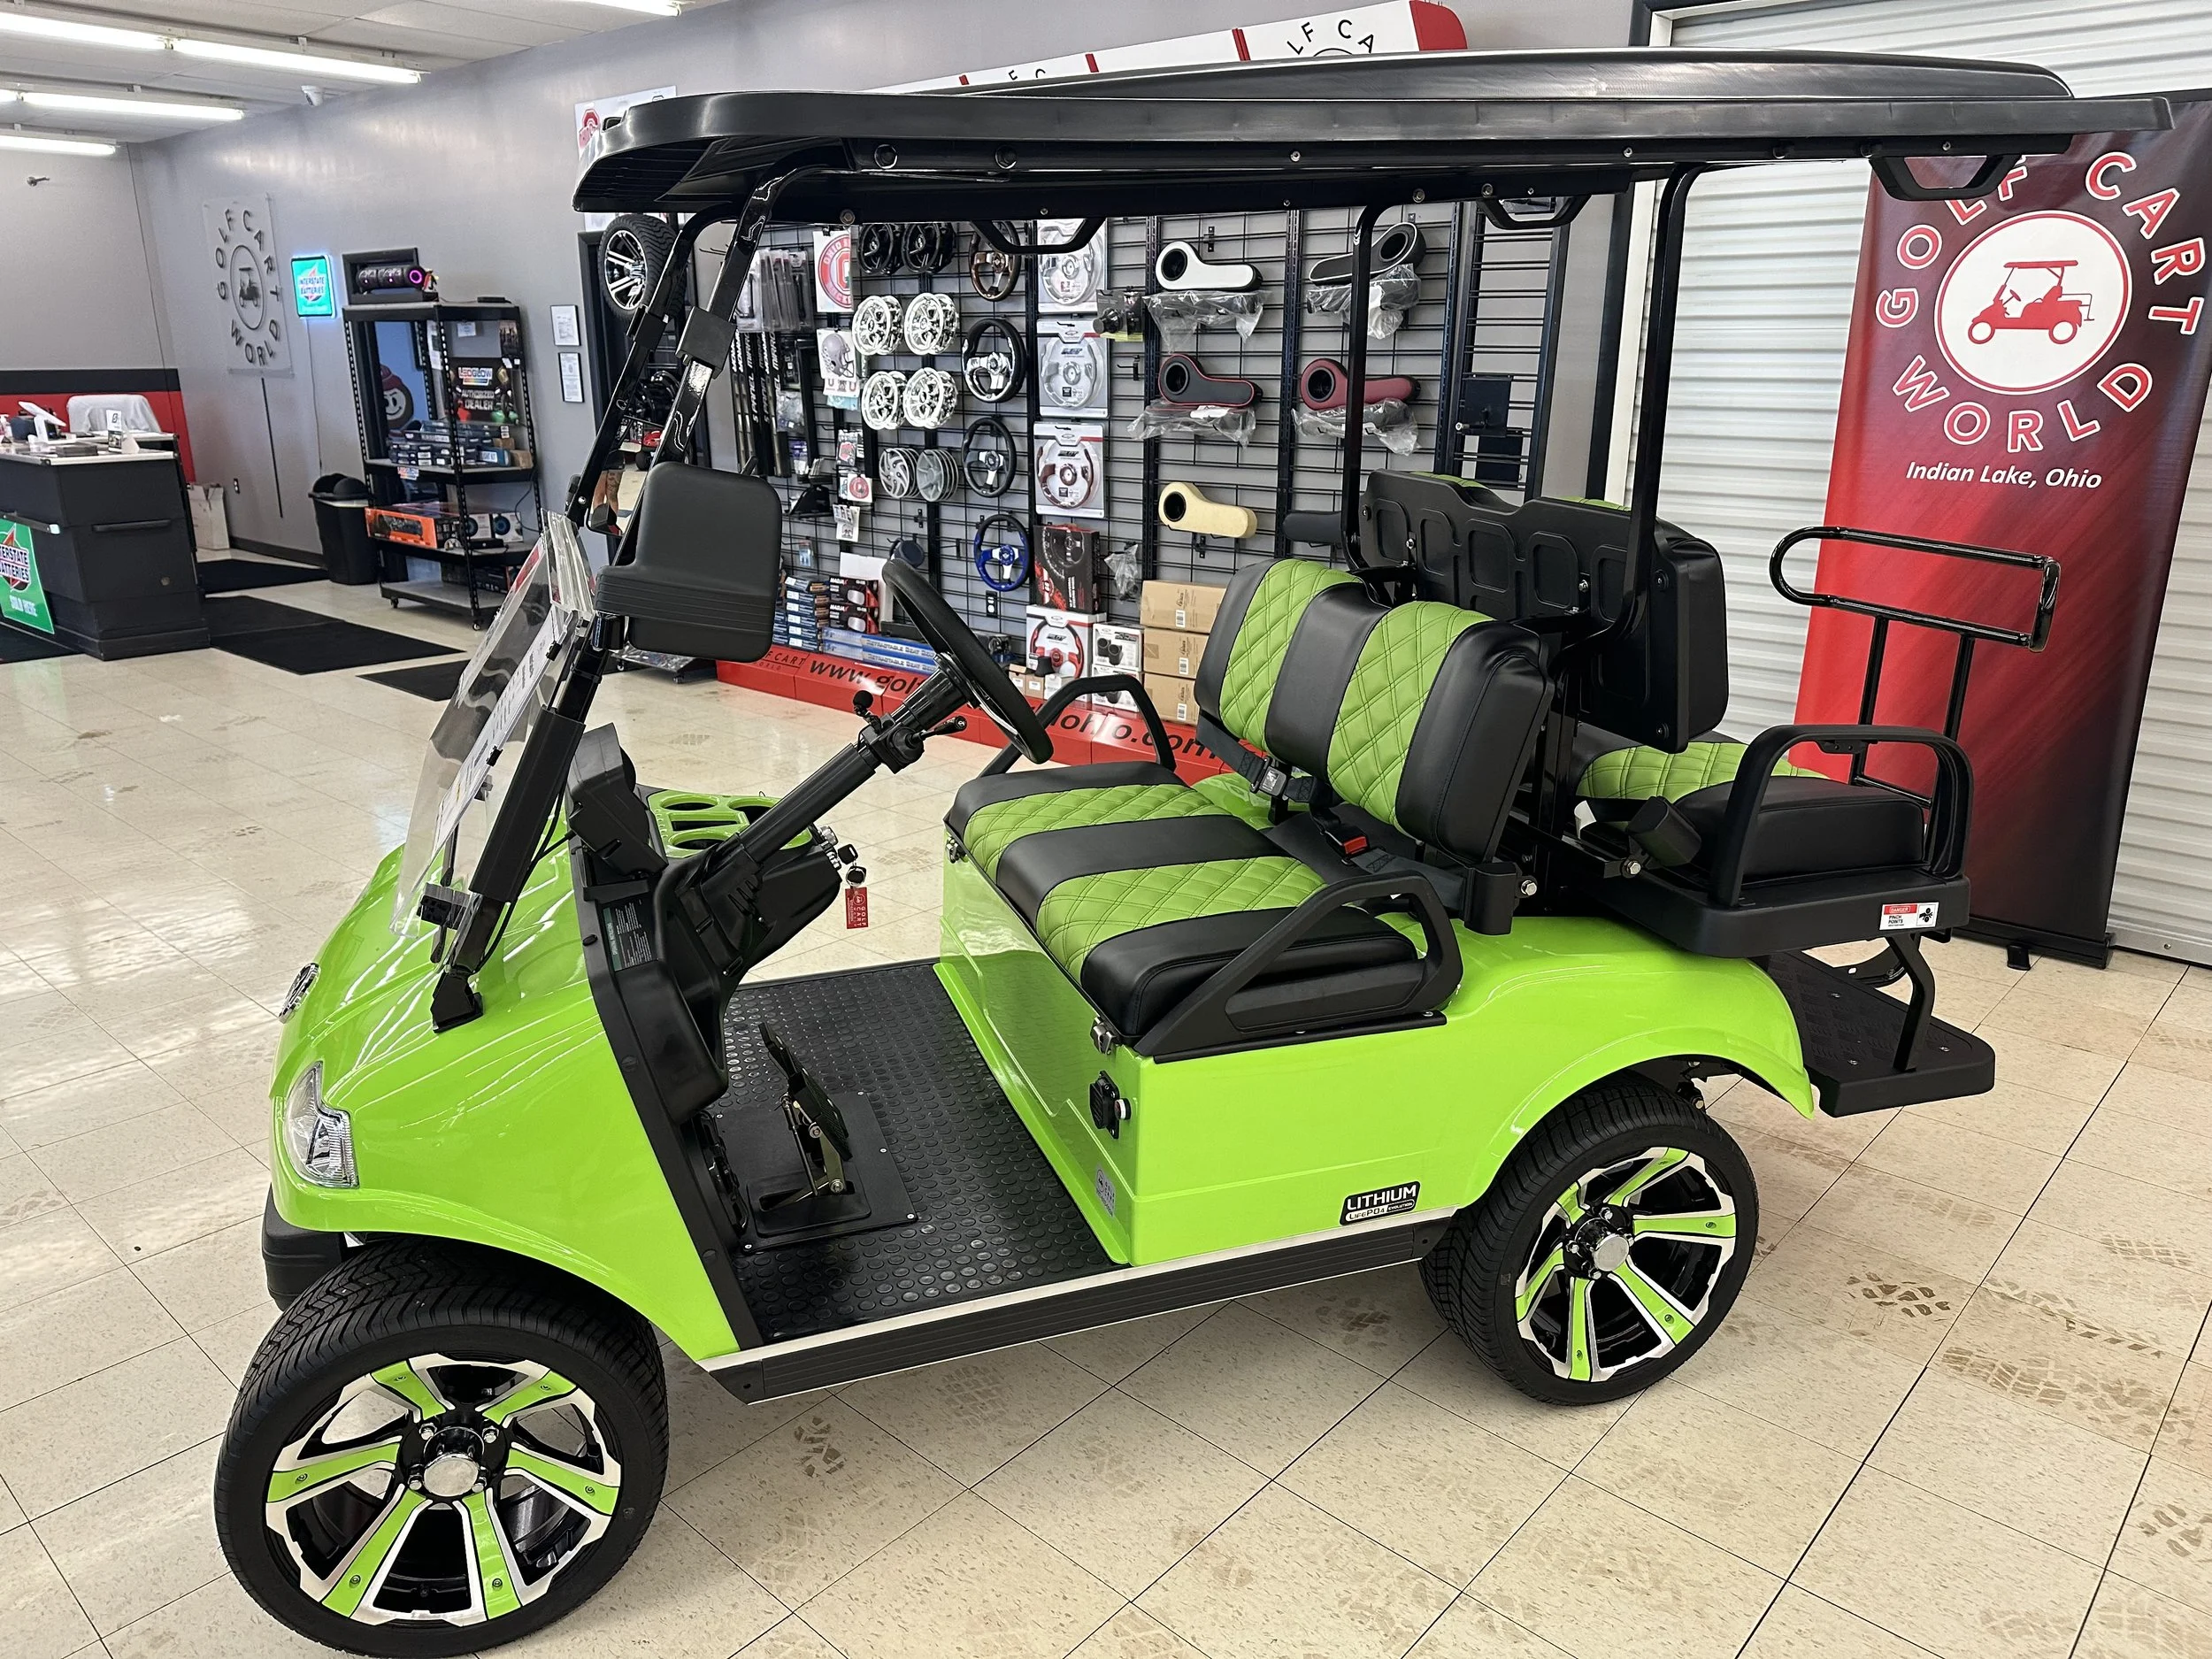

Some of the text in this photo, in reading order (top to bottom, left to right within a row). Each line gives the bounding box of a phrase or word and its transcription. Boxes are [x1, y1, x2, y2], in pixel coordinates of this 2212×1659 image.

[215, 208, 280, 302] GOLF CART
[2085, 151, 2206, 334] CART
[231, 319, 280, 366] WORLD
[465, 400, 494, 411] DEALER
[1893, 355, 2153, 453] WORLD
[1906, 461, 2102, 489] Indian Lake, Ohio
[758, 661, 782, 671] ORLD
[774, 652, 806, 666] CART
[1347, 1184, 1417, 1210] LITHIUM
